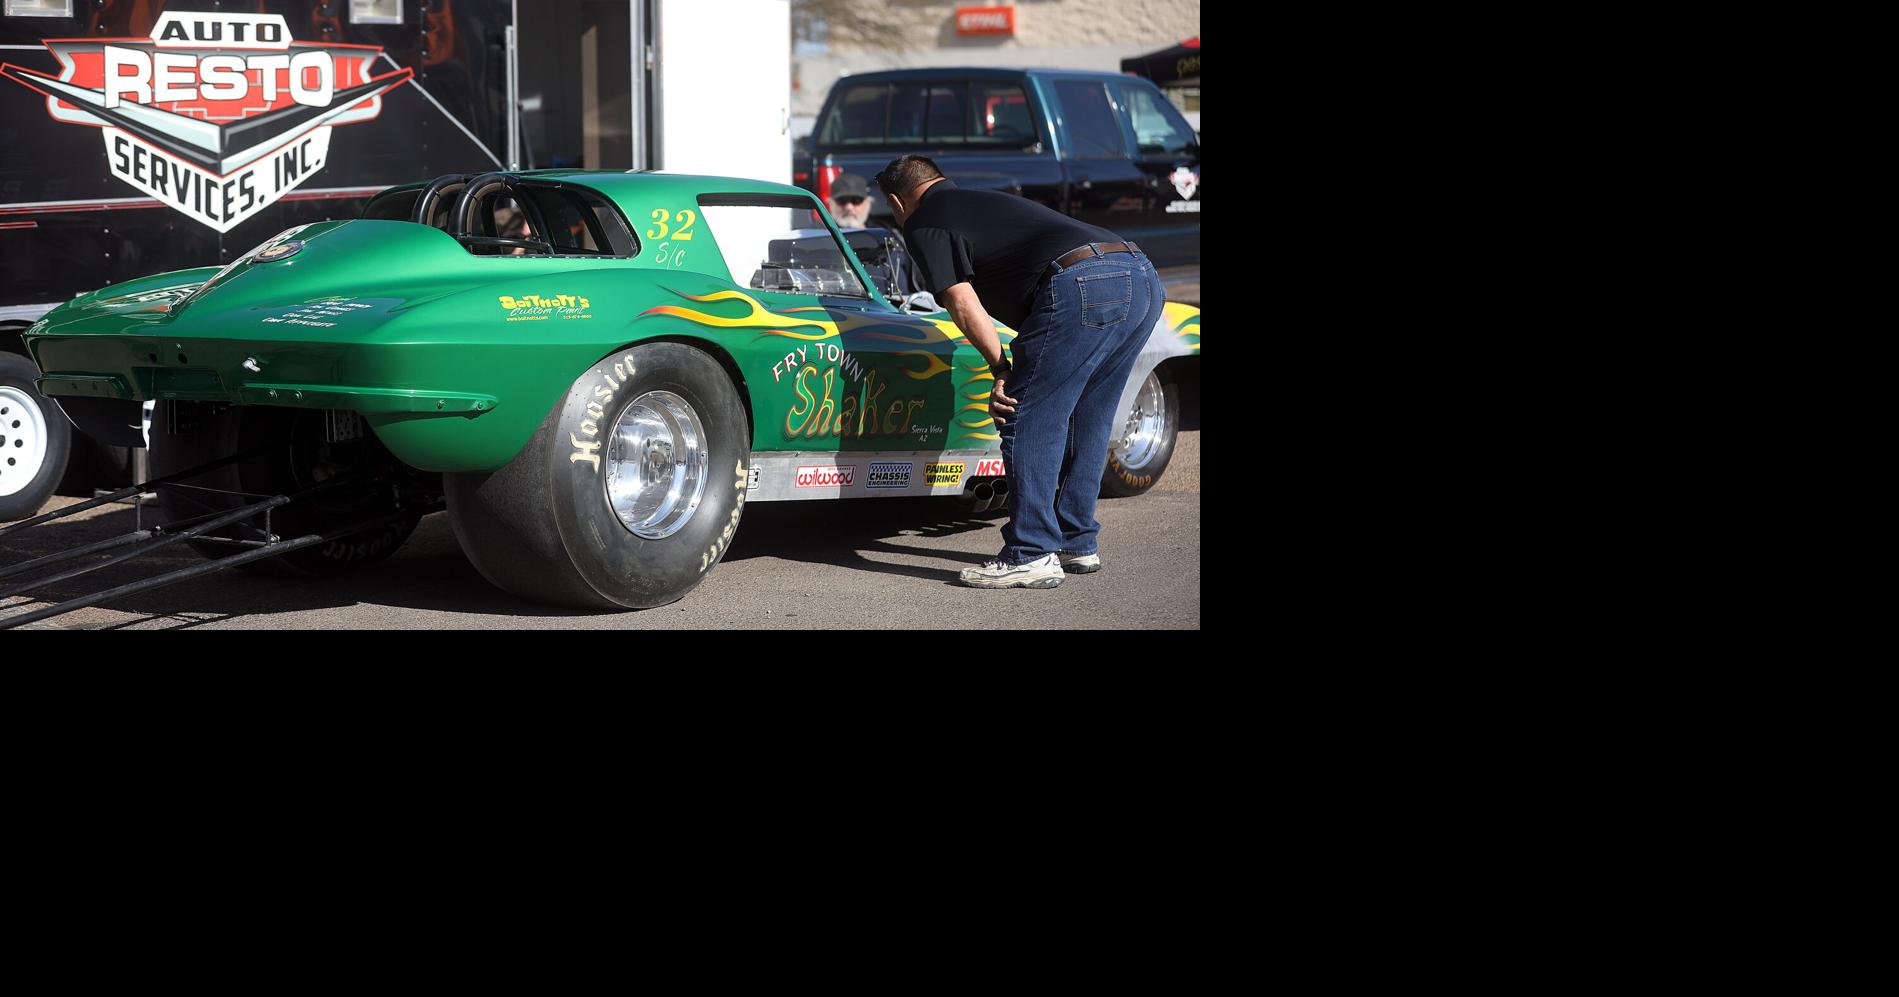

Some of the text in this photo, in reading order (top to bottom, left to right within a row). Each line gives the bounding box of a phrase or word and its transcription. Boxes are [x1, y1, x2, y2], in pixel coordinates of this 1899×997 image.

[159, 20, 282, 43] AUTO
[103, 45, 334, 109] RESTO
[114, 135, 322, 223] SERVICES, INC.
[646, 208, 696, 241] 32
[772, 343, 864, 383] FRY TOWN
[569, 353, 637, 474] Hoosier
[798, 468, 853, 486] wilwood
[869, 473, 911, 481] CHASSIS
[925, 464, 964, 475] PAINLESS
[926, 475, 960, 484] WIRING!
